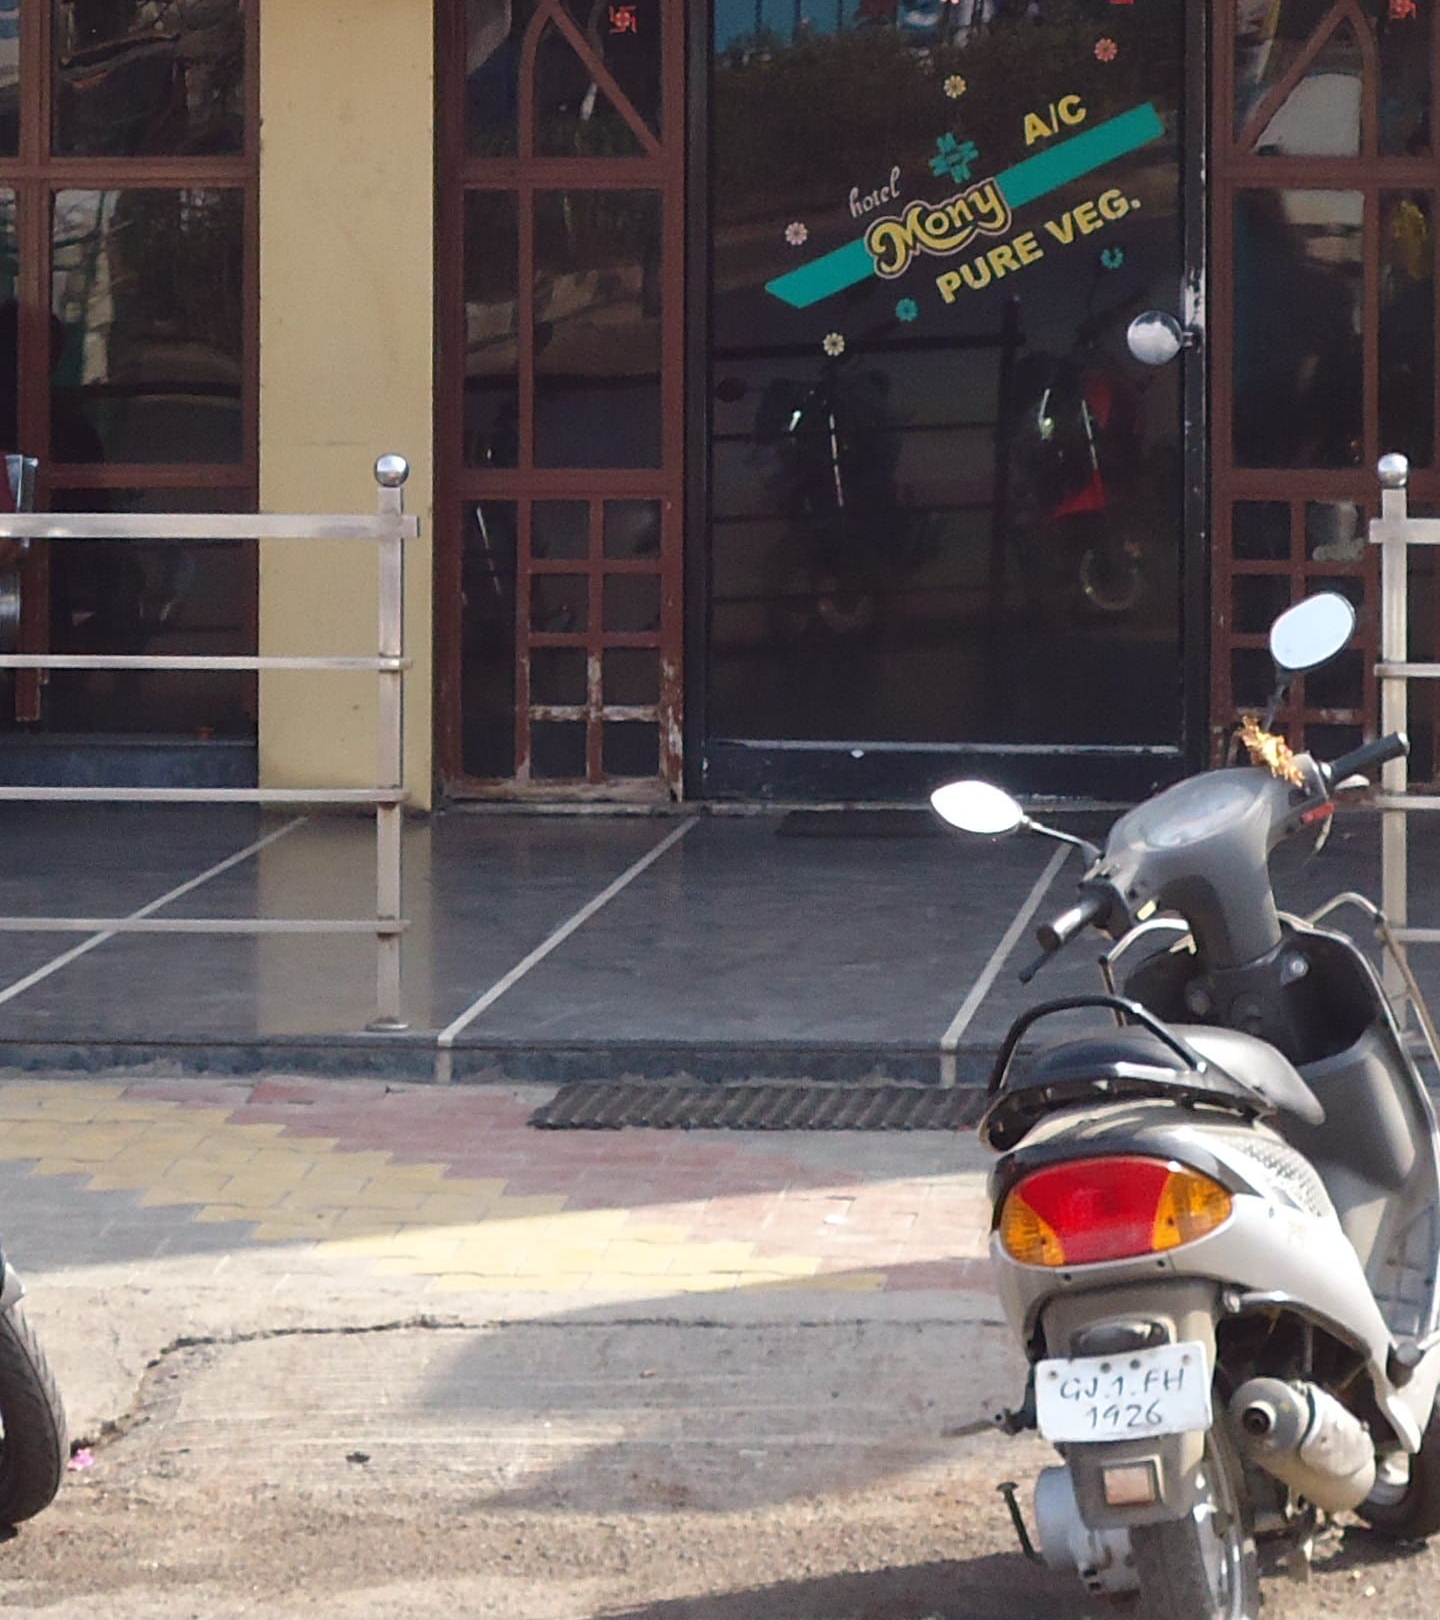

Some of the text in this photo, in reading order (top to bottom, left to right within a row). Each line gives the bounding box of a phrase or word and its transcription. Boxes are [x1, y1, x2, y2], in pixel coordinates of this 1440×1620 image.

[1023, 93, 1087, 146] A/C
[848, 165, 902, 219] hotel
[870, 184, 1007, 274] Mony
[935, 188, 1142, 305] PURE VEG.
[1086, 1398, 1163, 1429] 1926
